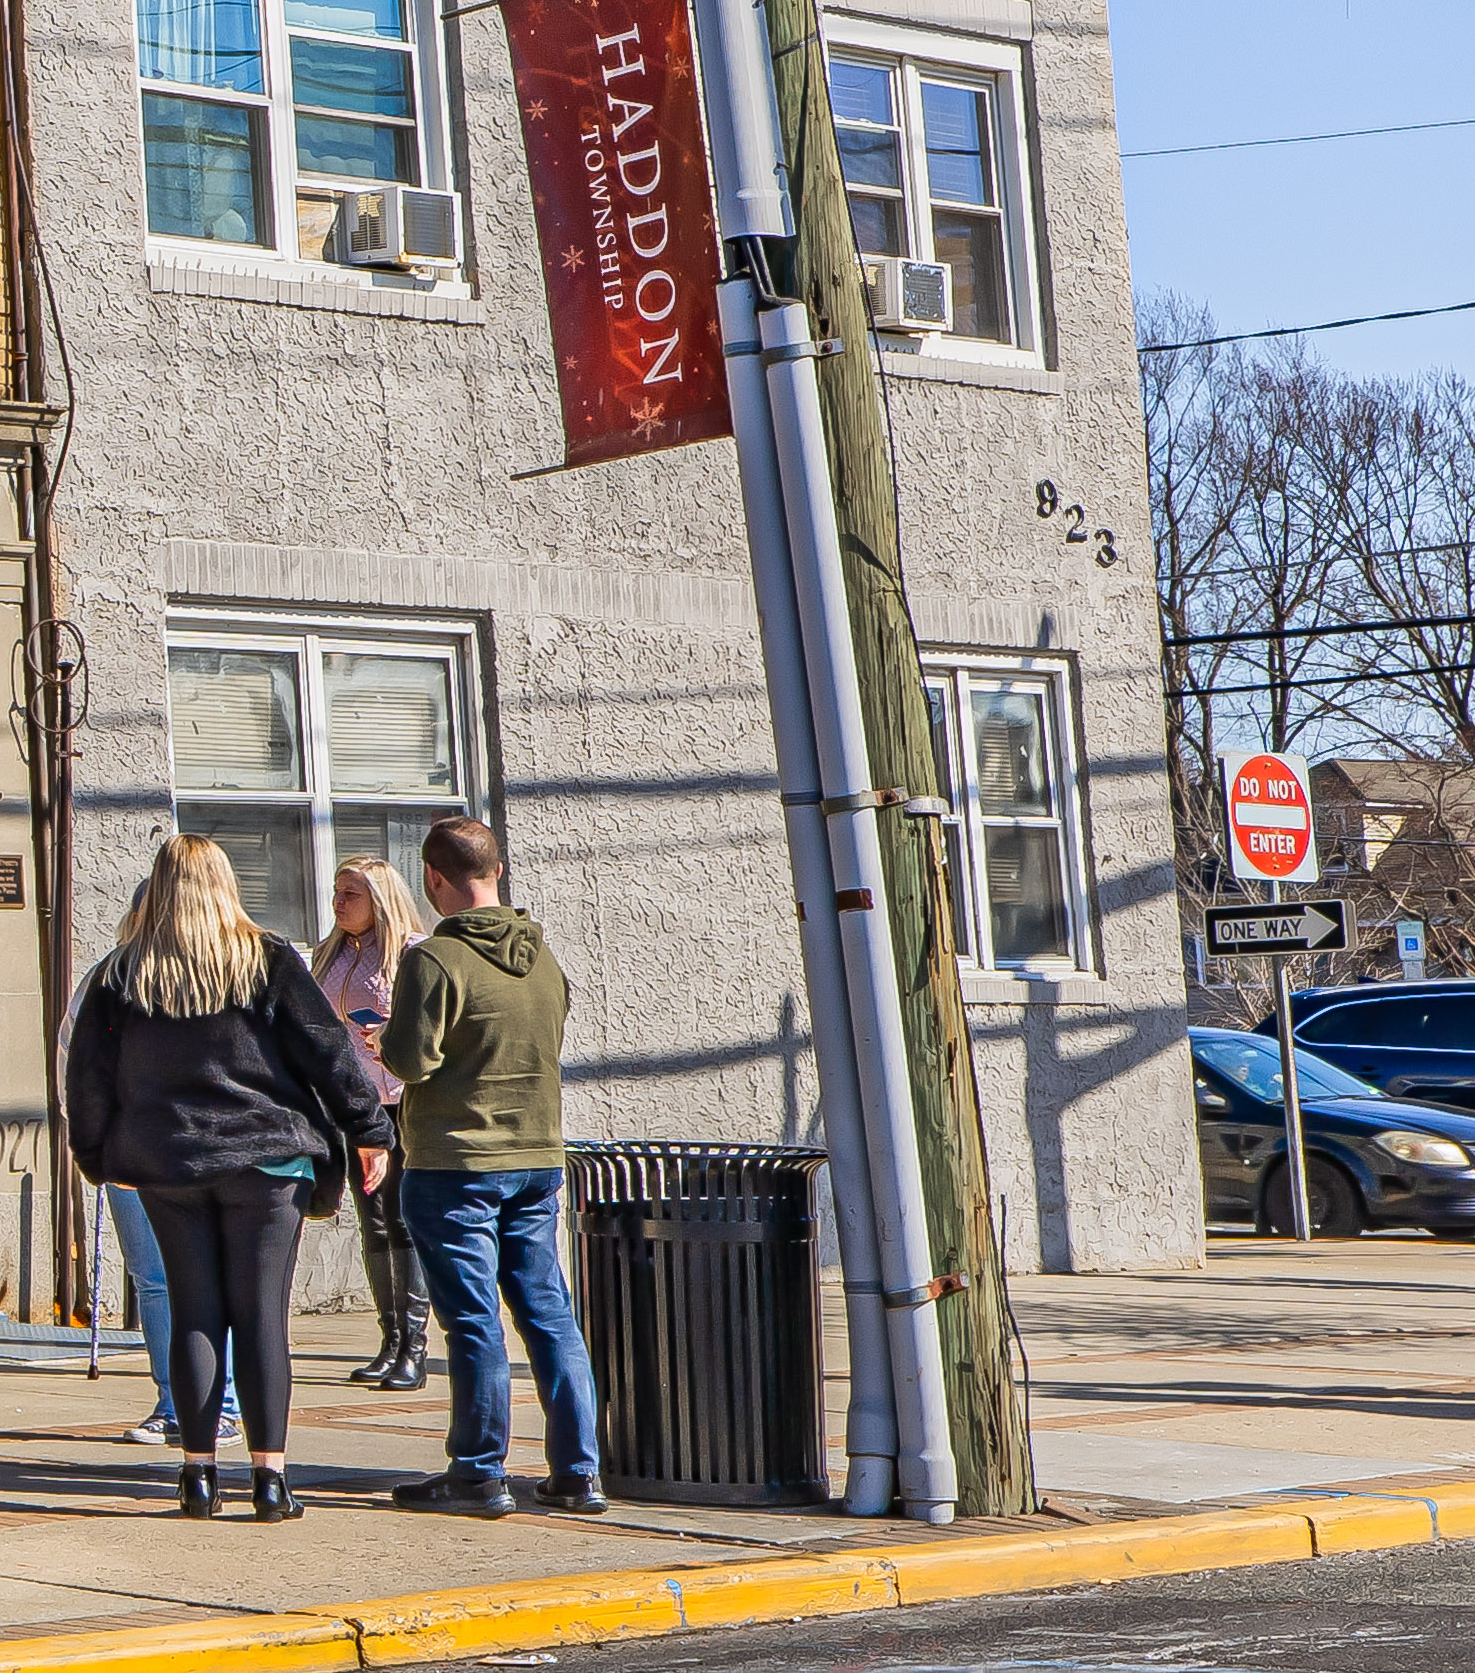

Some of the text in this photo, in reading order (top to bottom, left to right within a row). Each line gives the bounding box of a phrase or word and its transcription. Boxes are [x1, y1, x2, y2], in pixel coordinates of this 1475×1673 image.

[580, 123, 623, 311] TOWNSHIP
[595, 22, 684, 387] HADDON
[1035, 478, 1120, 569] 923
[1239, 776, 1297, 800] DO NOT
[1249, 833, 1296, 855] ENTER
[1220, 918, 1303, 941] ONE WAY
